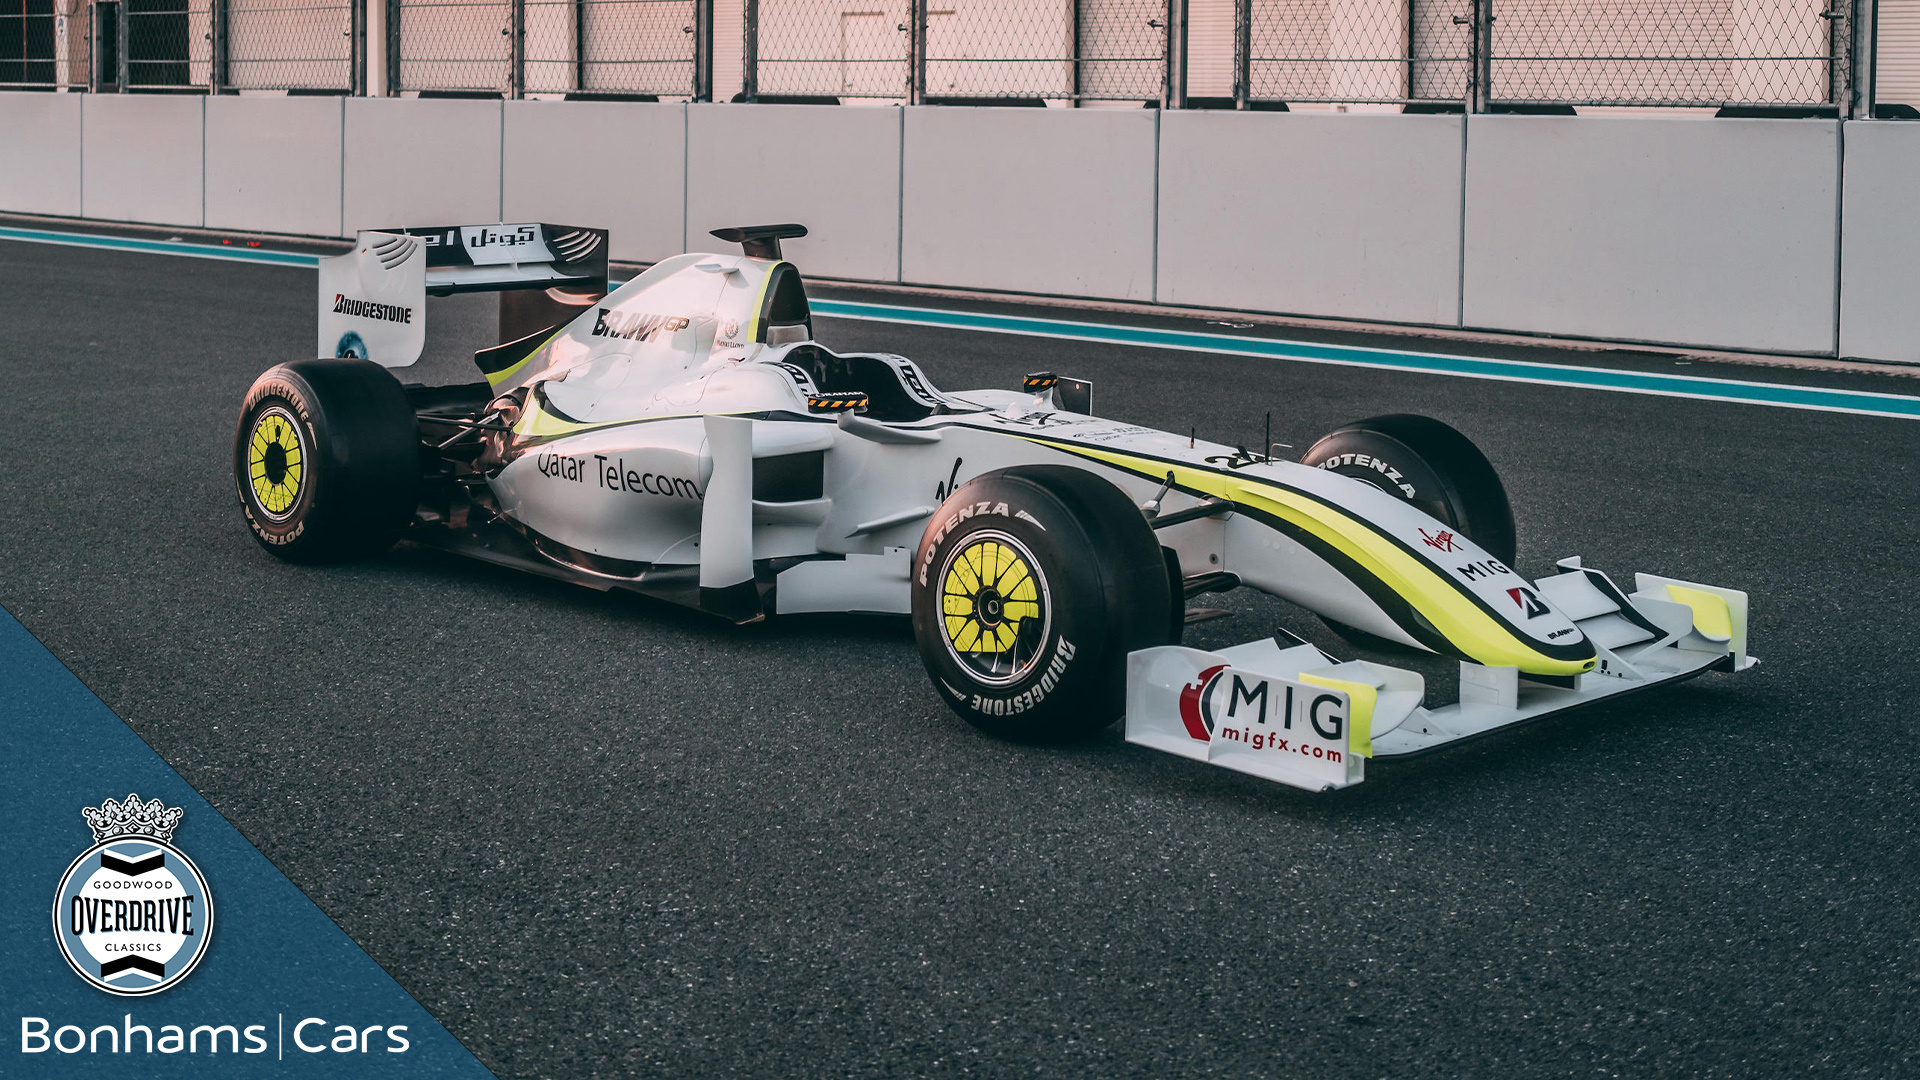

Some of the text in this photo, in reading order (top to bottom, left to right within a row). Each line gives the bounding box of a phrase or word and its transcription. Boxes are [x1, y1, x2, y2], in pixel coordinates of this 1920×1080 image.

[333, 294, 412, 324] BRIDGESTONE
[248, 383, 309, 421] BRIDGESTONE
[537, 445, 704, 500] Qatar Telecom
[245, 504, 305, 545] POTENZA
[919, 501, 1010, 588] POTENZA
[1456, 560, 1511, 582] MIG
[971, 634, 1077, 717] BRIDGESTONE
[1227, 674, 1343, 741] MIG
[1221, 727, 1342, 763] migfx.com
